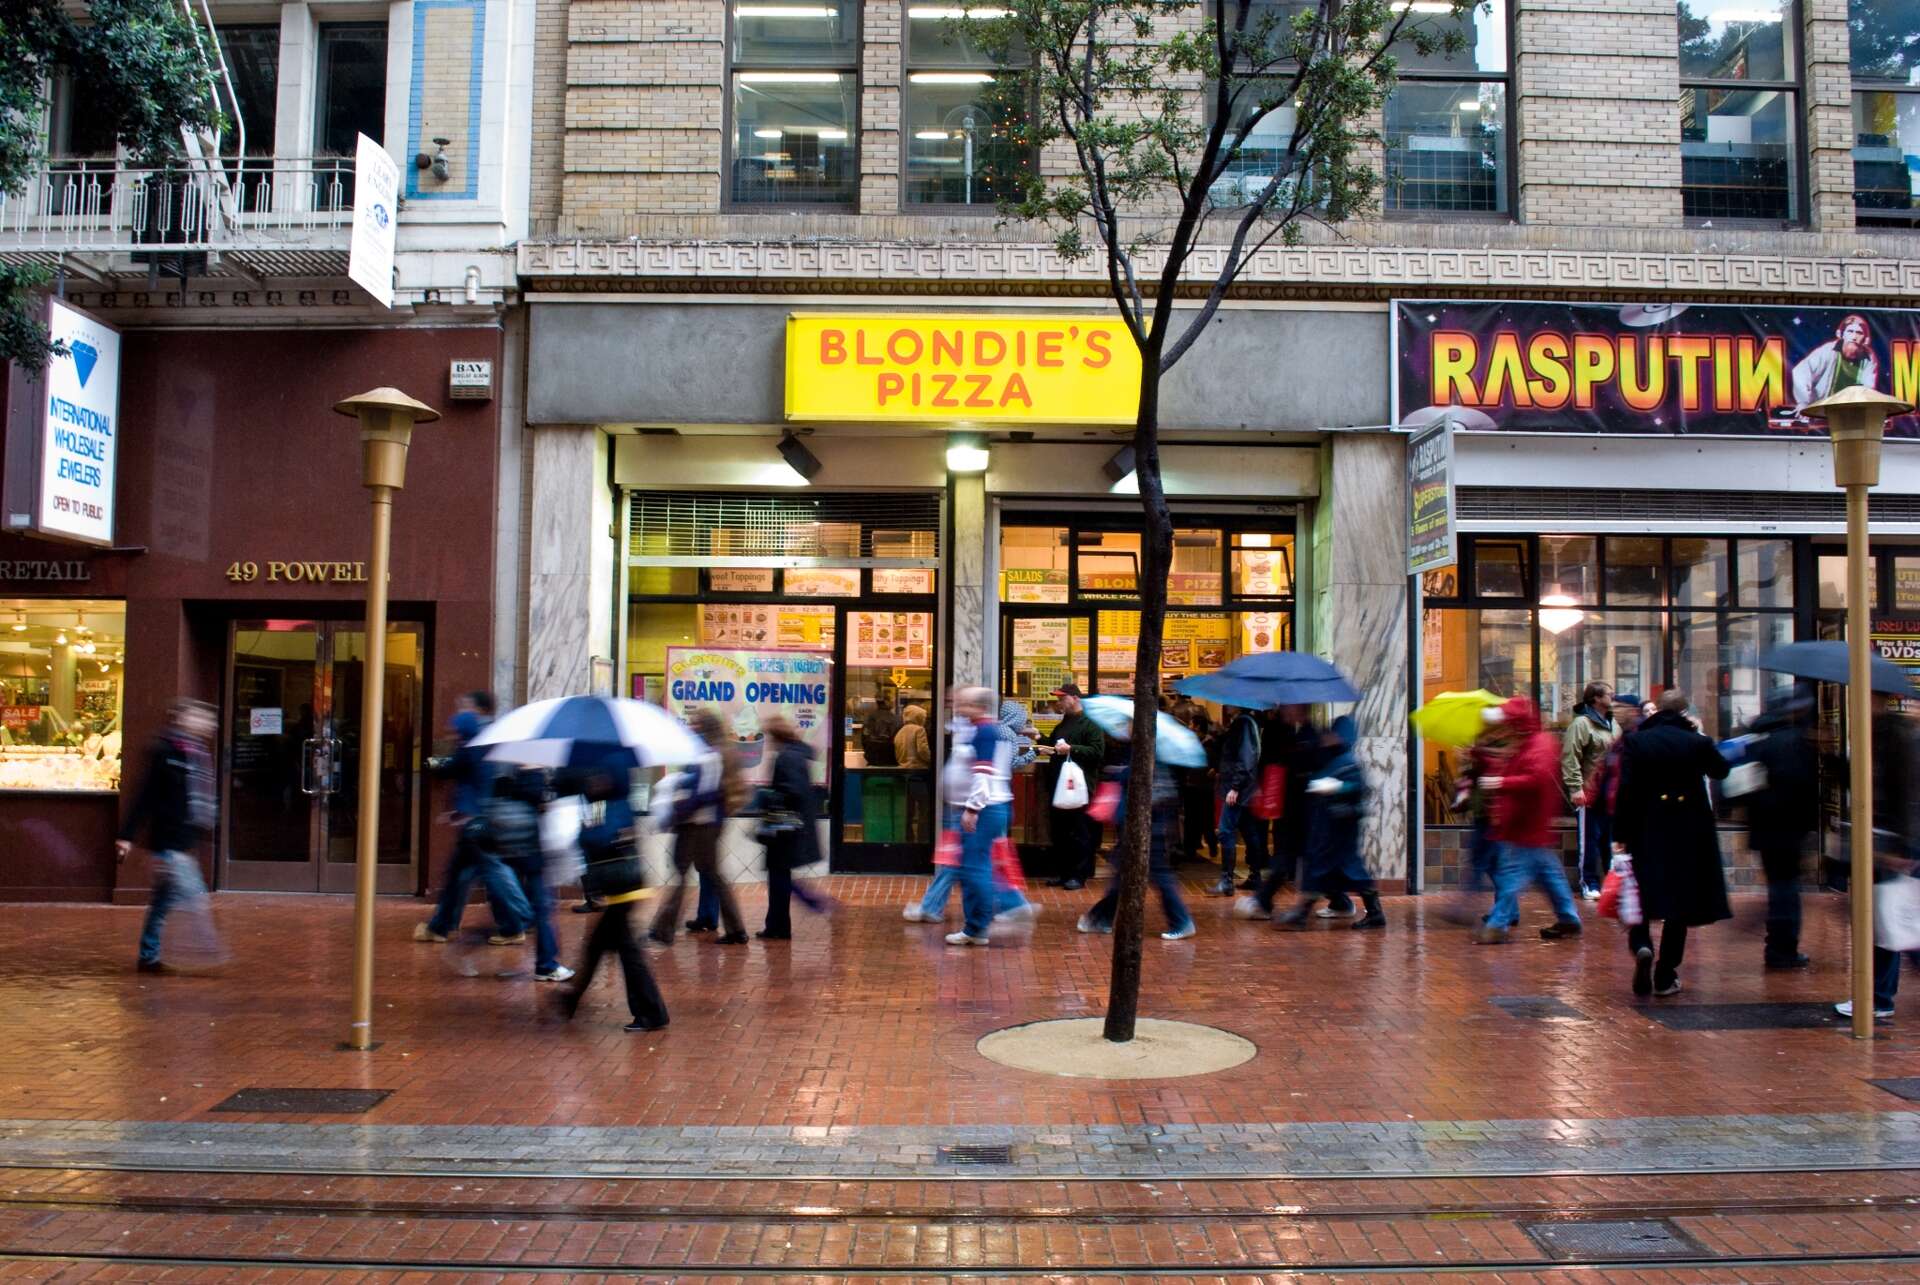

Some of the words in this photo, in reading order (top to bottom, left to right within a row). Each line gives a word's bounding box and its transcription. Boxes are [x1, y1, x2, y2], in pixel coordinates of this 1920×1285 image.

[820, 326, 1112, 369] BLONDIE'S
[456, 364, 485, 373] BAY
[1431, 331, 1785, 412] RASPUTIN
[877, 373, 1033, 408] PIZZA
[51, 395, 112, 436] INTERNATIONAL
[54, 425, 105, 462] WHOLESALE
[57, 458, 101, 488] JEWELERS
[53, 495, 70, 512] OPEN
[72, 499, 80, 515] TO
[82, 502, 104, 521] PUBLIC
[0, 560, 91, 580] RETAIL
[226, 561, 258, 582] 49
[267, 561, 391, 582] POWEL
[730, 571, 766, 583] Toppings
[890, 573, 924, 585] Toppings
[1007, 570, 1043, 583] SALADS
[1184, 578, 1221, 590] PIZZ
[671, 679, 736, 702] GRAND
[745, 682, 826, 705] OPENING
[4, 708, 36, 718] SALE
